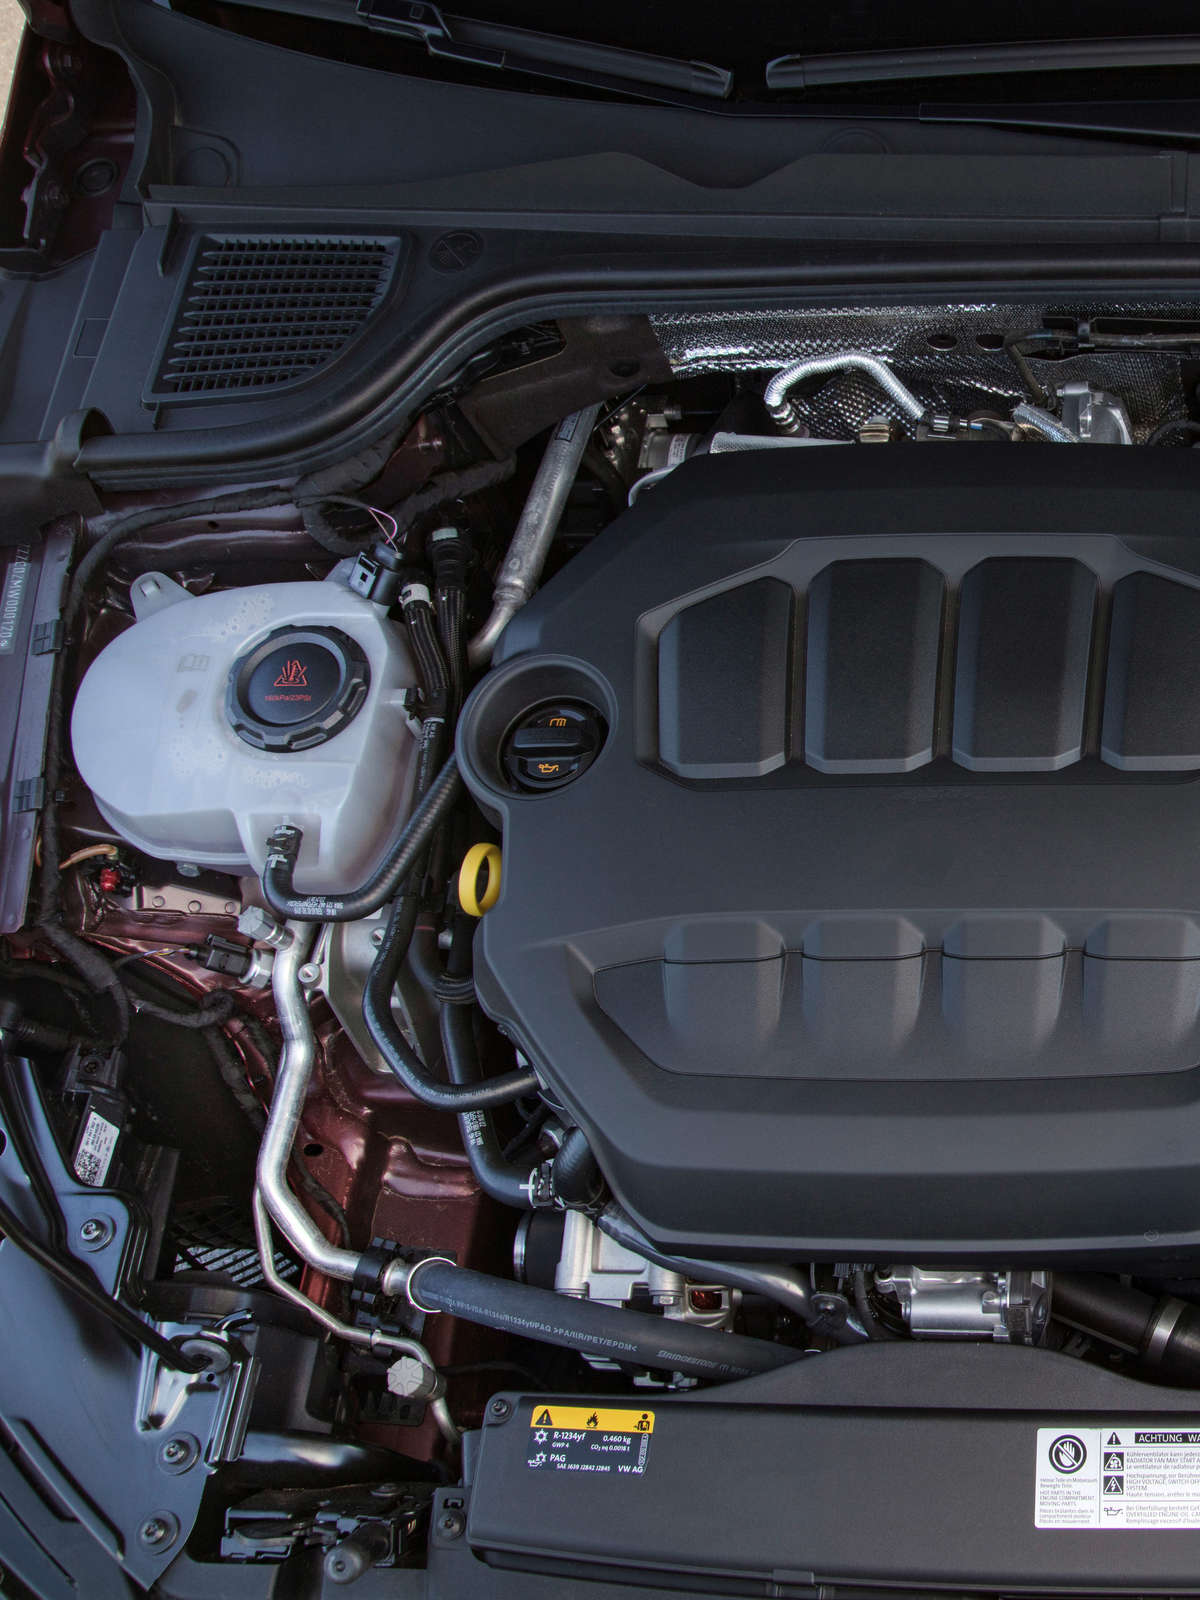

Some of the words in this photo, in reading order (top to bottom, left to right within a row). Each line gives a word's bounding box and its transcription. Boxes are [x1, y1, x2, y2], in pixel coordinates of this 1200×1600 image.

[552, 1432, 586, 1441] R-1234yf
[622, 1436, 631, 1444] kg
[1139, 1434, 1182, 1442] ACHTUNG
[550, 1454, 566, 1462] PAG
